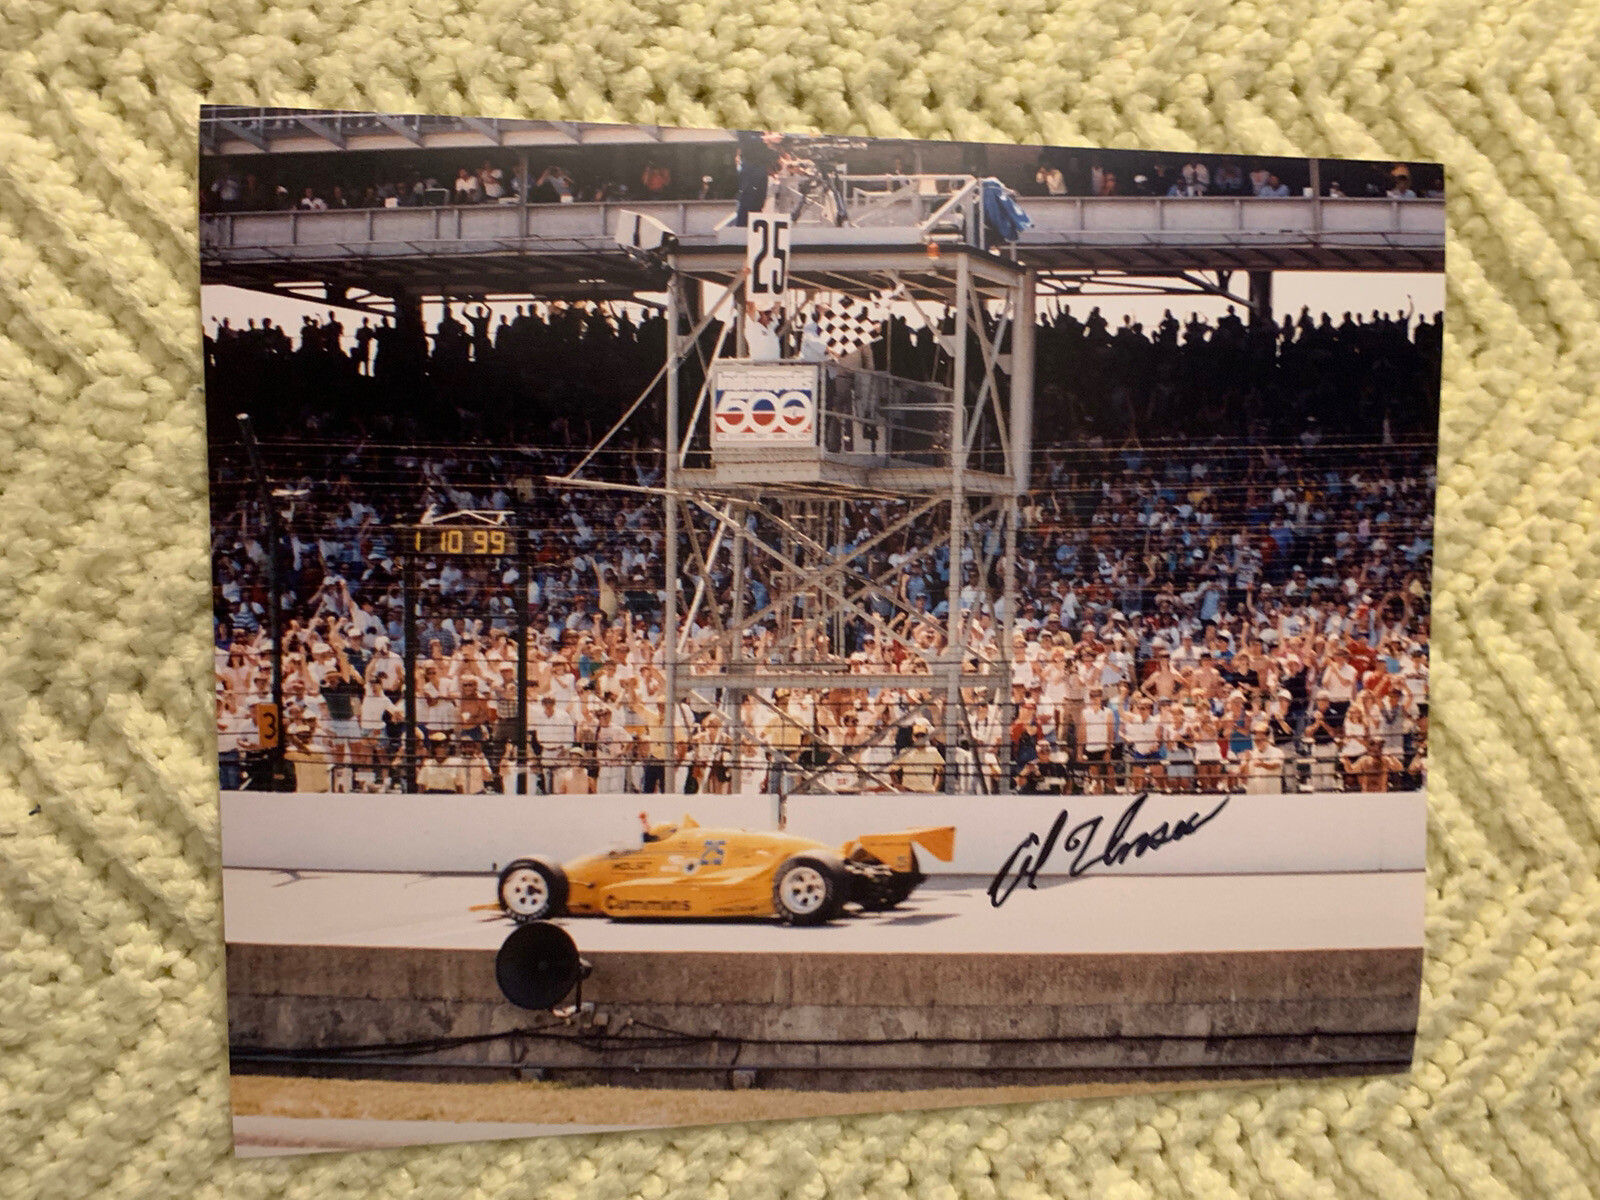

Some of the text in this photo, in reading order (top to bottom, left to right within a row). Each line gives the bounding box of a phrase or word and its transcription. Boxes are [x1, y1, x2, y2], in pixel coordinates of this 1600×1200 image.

[752, 219, 788, 294] 25
[714, 390, 813, 434] 500
[440, 530, 463, 554] 10
[473, 530, 506, 554] 99
[262, 711, 276, 740] 3
[605, 893, 692, 912] Cummins
